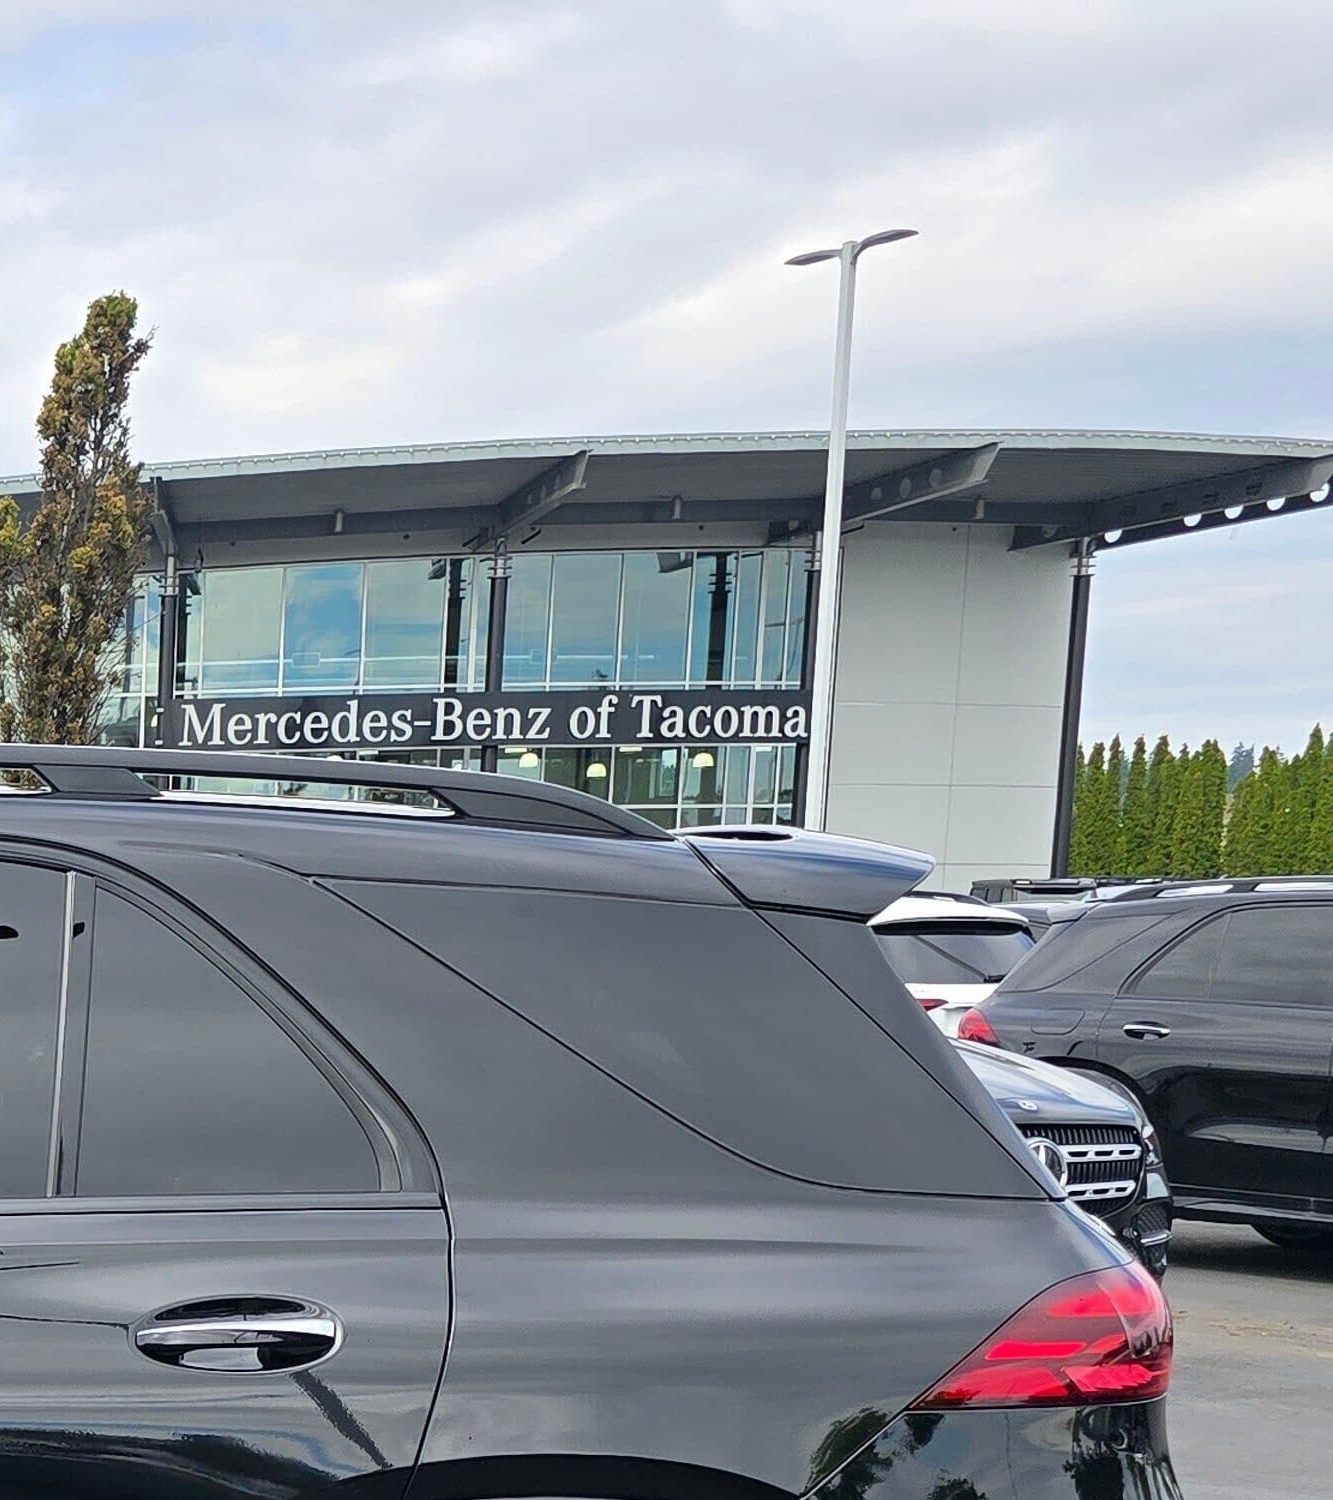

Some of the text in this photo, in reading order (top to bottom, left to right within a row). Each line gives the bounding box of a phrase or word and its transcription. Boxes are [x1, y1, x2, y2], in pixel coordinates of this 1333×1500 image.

[178, 694, 808, 746] Mercedes-Benz of Tacoma
